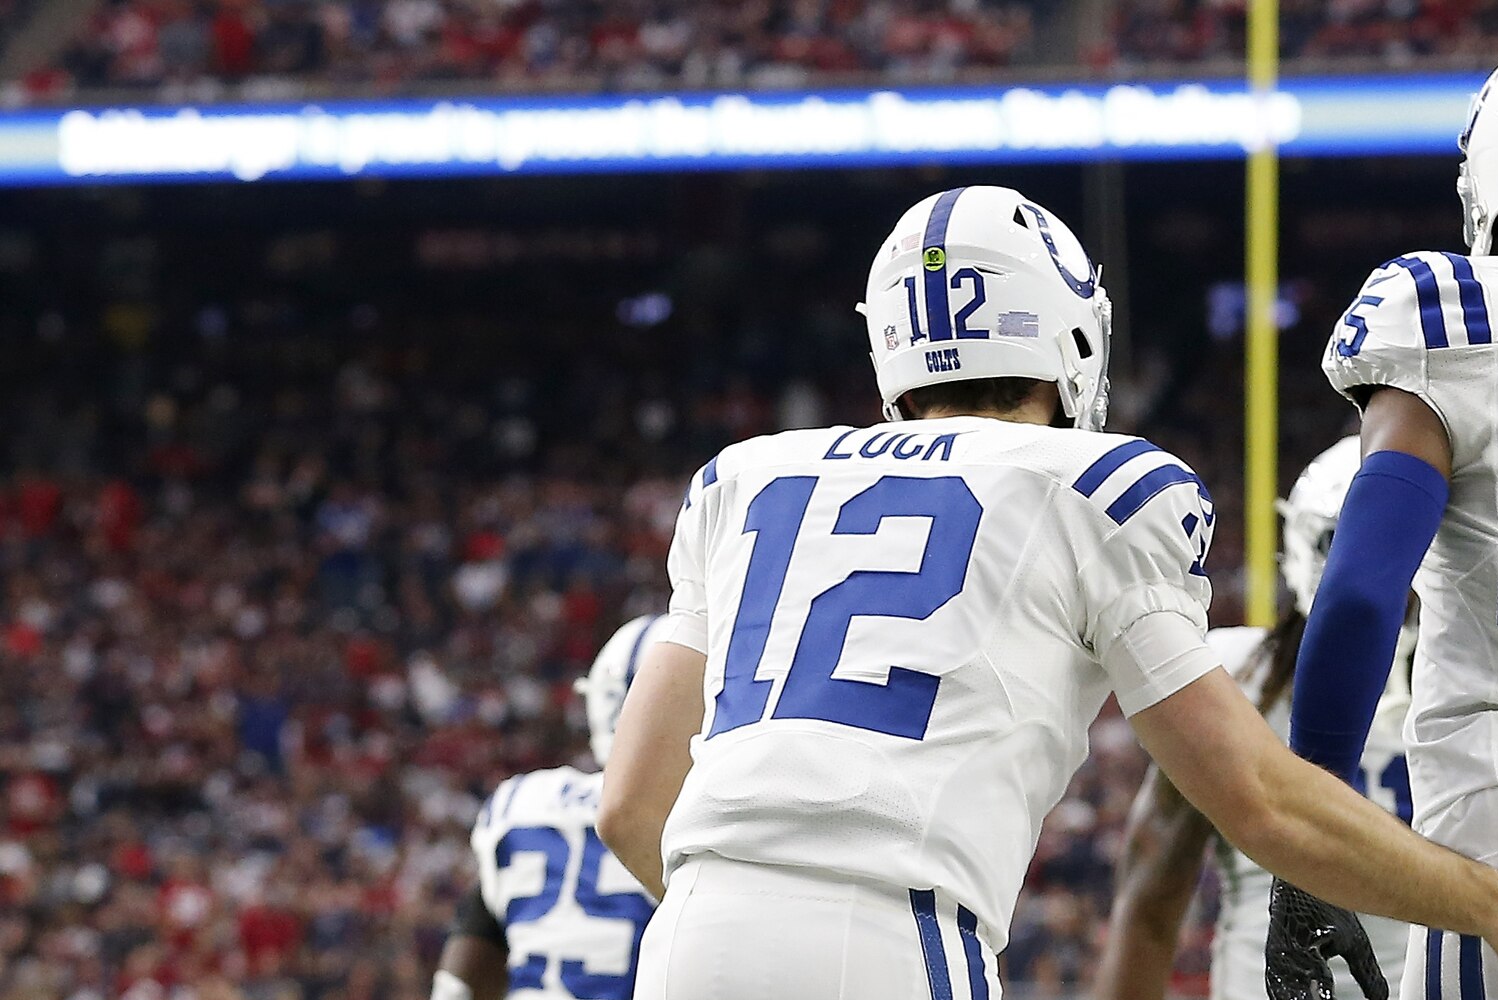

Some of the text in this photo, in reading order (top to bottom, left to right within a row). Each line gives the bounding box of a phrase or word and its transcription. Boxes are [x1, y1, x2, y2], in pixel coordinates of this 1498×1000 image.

[904, 267, 990, 347] 12
[1329, 294, 1385, 361] 5
[925, 347, 961, 373] COLTS
[704, 475, 984, 741] 12
